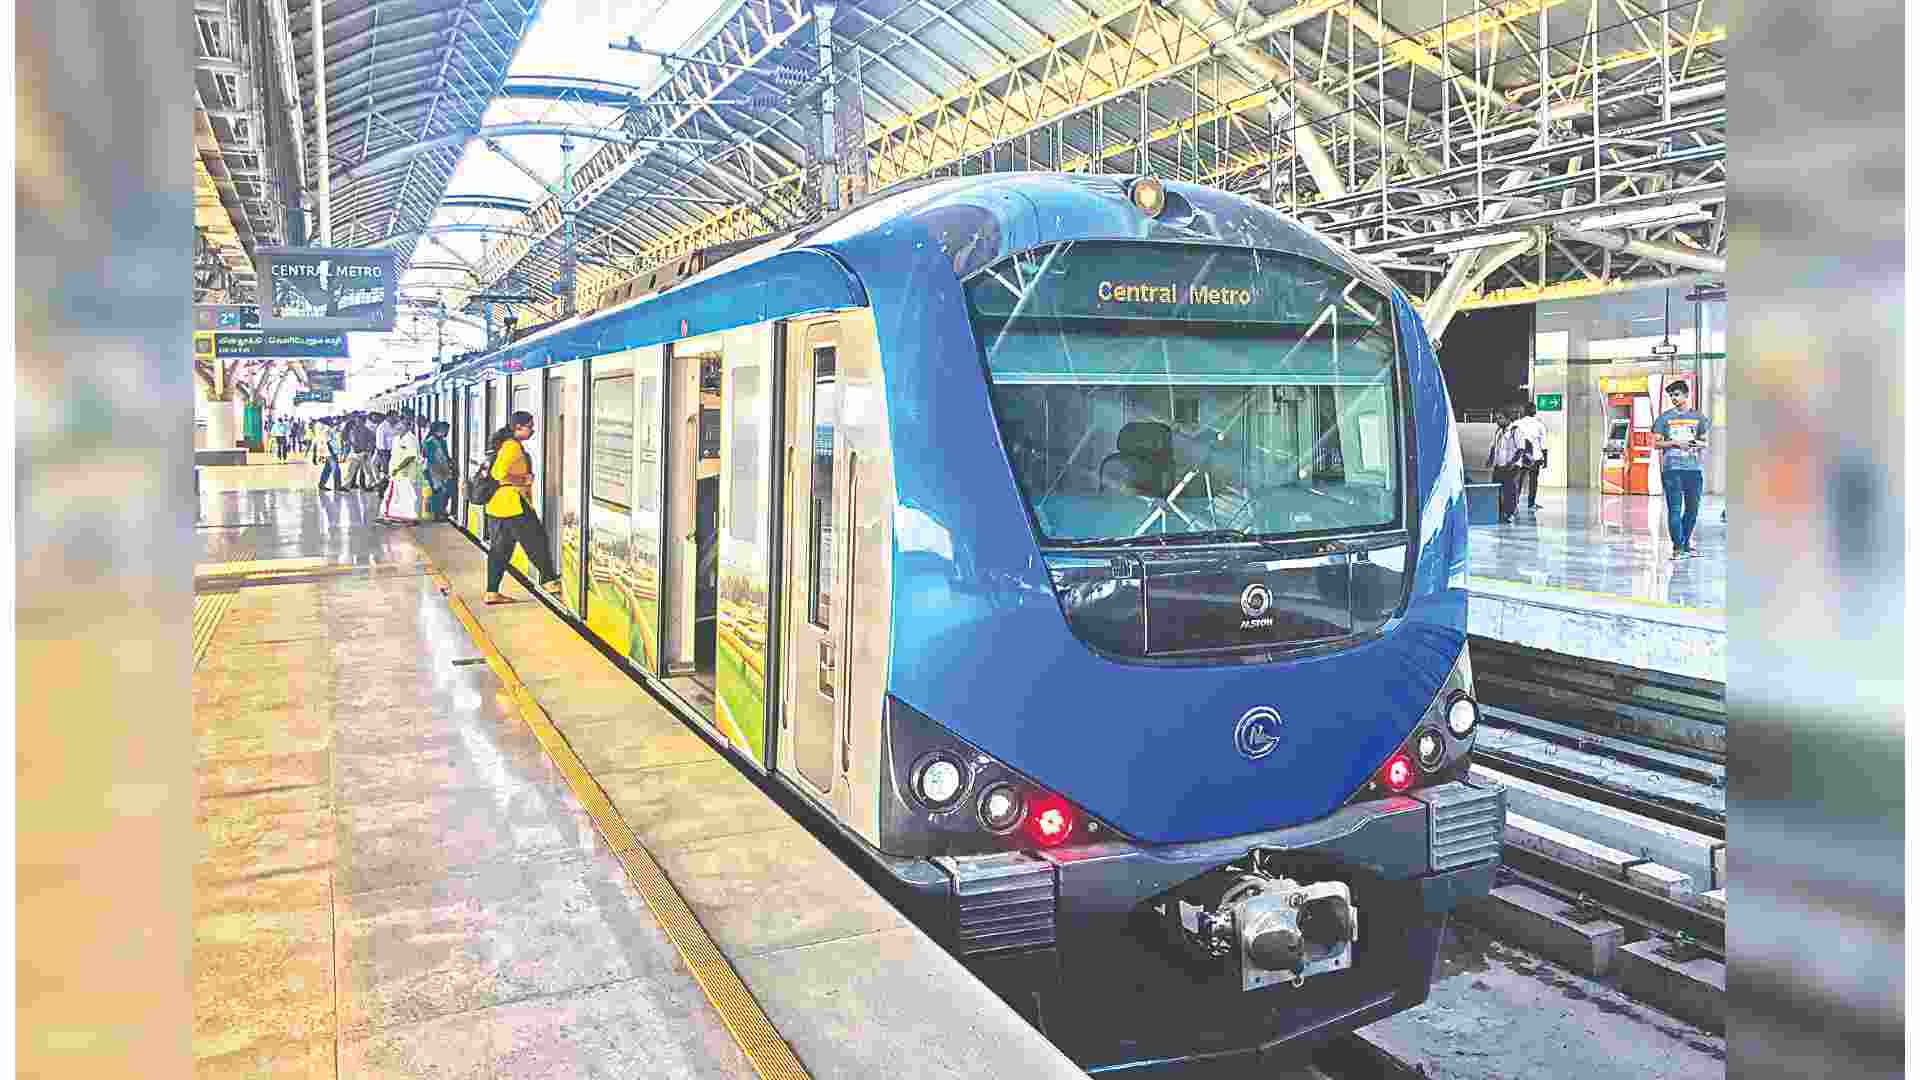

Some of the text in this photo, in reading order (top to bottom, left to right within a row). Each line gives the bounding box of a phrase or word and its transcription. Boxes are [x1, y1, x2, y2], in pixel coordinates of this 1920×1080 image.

[336, 265, 382, 278] METRO
[1098, 281, 1251, 305] Central Metro
